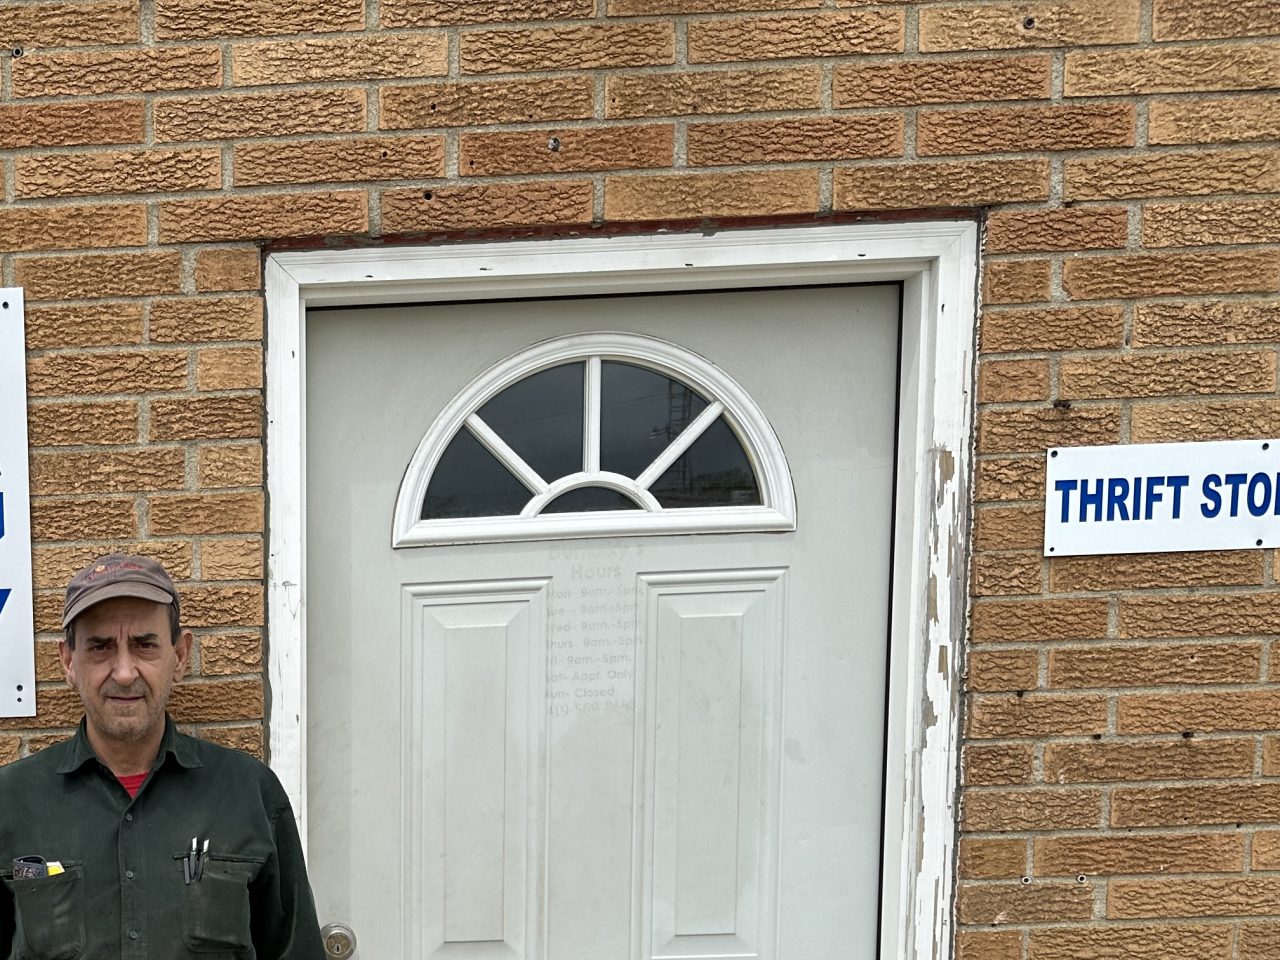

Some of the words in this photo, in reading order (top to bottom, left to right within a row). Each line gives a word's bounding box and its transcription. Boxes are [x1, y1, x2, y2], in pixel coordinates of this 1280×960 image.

[1055, 475, 1189, 523] THRIFT
[570, 565, 622, 580] Hours
[574, 686, 616, 699] Closed
